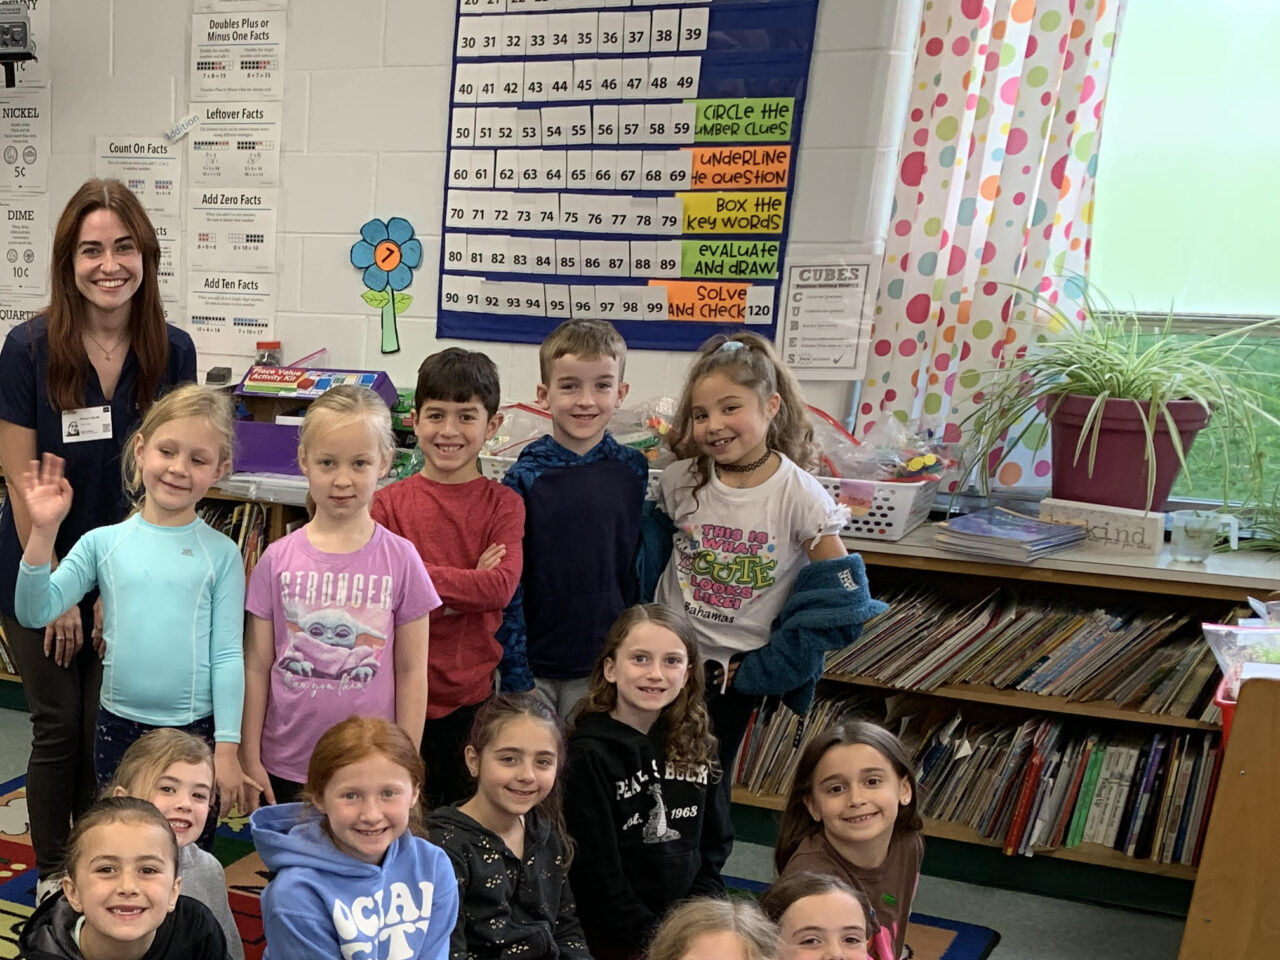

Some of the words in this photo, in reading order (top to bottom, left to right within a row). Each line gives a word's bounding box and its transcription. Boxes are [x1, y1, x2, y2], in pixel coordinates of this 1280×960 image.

[209, 18, 239, 29] Doubles
[241, 18, 258, 28] Plus
[261, 20, 269, 28] or
[208, 32, 230, 41] Minus
[232, 31, 248, 40] One
[250, 31, 269, 40] Facts
[461, 37, 476, 49] 30
[483, 36, 496, 48] 31
[506, 35, 521, 47] 32
[530, 34, 545, 47] 33
[552, 33, 568, 45] 34
[577, 32, 592, 45] 35
[602, 32, 618, 44] 36
[628, 31, 644, 44] 37
[656, 29, 673, 42] 38
[685, 28, 702, 41] 39
[2, 107, 39, 119] NICKEL
[206, 108, 240, 120] Leftover
[242, 108, 264, 120] Facts
[109, 142, 132, 154] Count
[134, 143, 145, 153] On
[147, 143, 168, 154] Facts
[14, 166, 26, 178] 5¢
[202, 194, 218, 205] Add
[220, 194, 238, 205] Zero
[240, 194, 261, 205] Facts
[7, 210, 34, 221] DIME
[12, 267, 29, 278] 10¢
[799, 268, 859, 282] CUBES
[204, 278, 220, 289] Add
[221, 279, 236, 290] Ten
[238, 279, 259, 291] Facts
[792, 292, 803, 302] C
[748, 305, 770, 316] 120
[792, 306, 801, 317] U
[790, 321, 799, 331] B
[789, 337, 797, 348] E
[787, 354, 795, 364] S
[253, 367, 277, 375] Place
[251, 373, 279, 382] Activity
[281, 374, 297, 382] Kit
[702, 524, 743, 541] THIS
[748, 531, 769, 544] IS
[1085, 520, 1146, 545] kind
[702, 537, 764, 555] WHAT
[693, 550, 778, 589] CUTE
[280, 571, 393, 609] STRONGER
[691, 574, 753, 598] LOOKS
[684, 601, 735, 624] Bahamas
[671, 806, 698, 819] 1968
